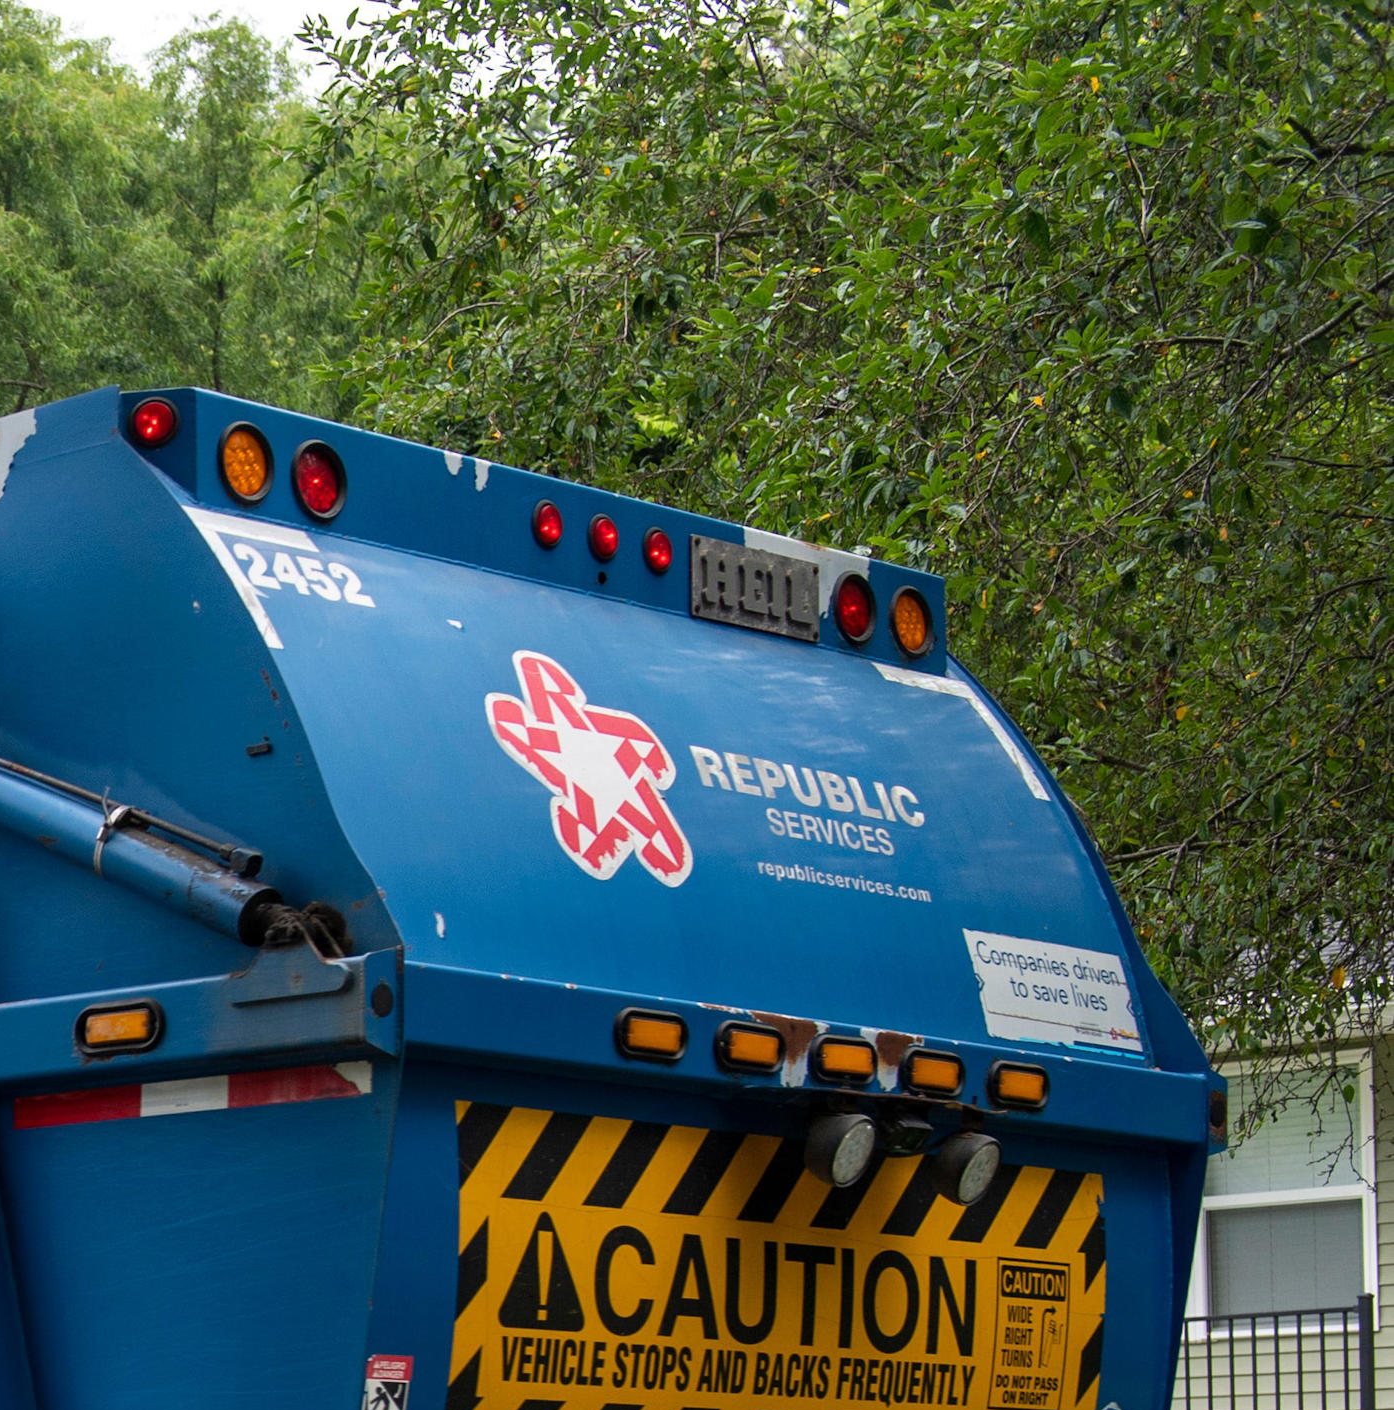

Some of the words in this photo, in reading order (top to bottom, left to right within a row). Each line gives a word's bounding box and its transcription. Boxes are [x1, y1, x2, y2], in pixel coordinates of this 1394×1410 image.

[233, 543, 376, 608] 2452
[699, 551, 814, 626] HEIL
[689, 745, 925, 827] REPUBLIC
[766, 808, 895, 856] SERVICES
[757, 861, 932, 902] republicservices.com
[976, 940, 1069, 977] Companies
[1072, 957, 1120, 986] driven
[1010, 977, 1028, 998] to
[1033, 984, 1068, 1005] save
[1070, 983, 1108, 1012] lives
[594, 1225, 977, 1357] CAUTION
[1002, 1270, 1065, 1297] CAUTION
[1007, 1304, 1033, 1323] WIDE
[1004, 1327, 1034, 1346] RIGHT
[502, 1336, 607, 1386] VEHICLE
[612, 1342, 692, 1392] STOPS
[696, 1349, 748, 1394] AND
[752, 1352, 830, 1399] BACKS
[836, 1357, 976, 1408] FREQUENTLY
[1001, 1349, 1033, 1368] TURNS
[996, 1374, 1010, 1388] DO
[1012, 1375, 1032, 1389] NOT
[1034, 1377, 1058, 1391] PASS
[1002, 1390, 1017, 1404] ON
[1019, 1392, 1049, 1406] RIGHT
